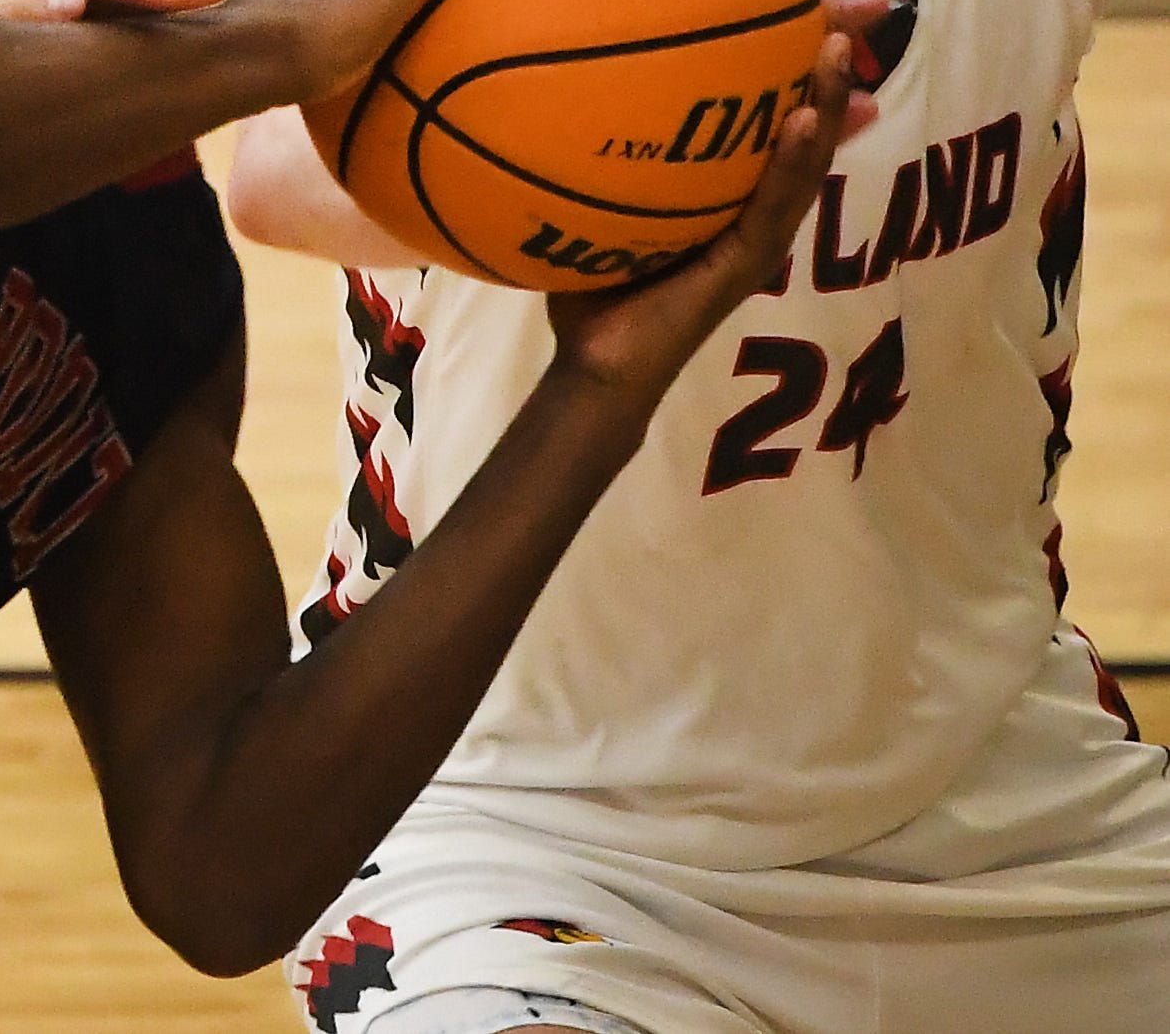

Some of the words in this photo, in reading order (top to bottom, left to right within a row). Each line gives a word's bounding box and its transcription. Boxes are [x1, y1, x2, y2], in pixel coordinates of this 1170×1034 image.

[593, 137, 663, 160] NXT
[752, 113, 1021, 297] LAND
[701, 320, 911, 496] 24
